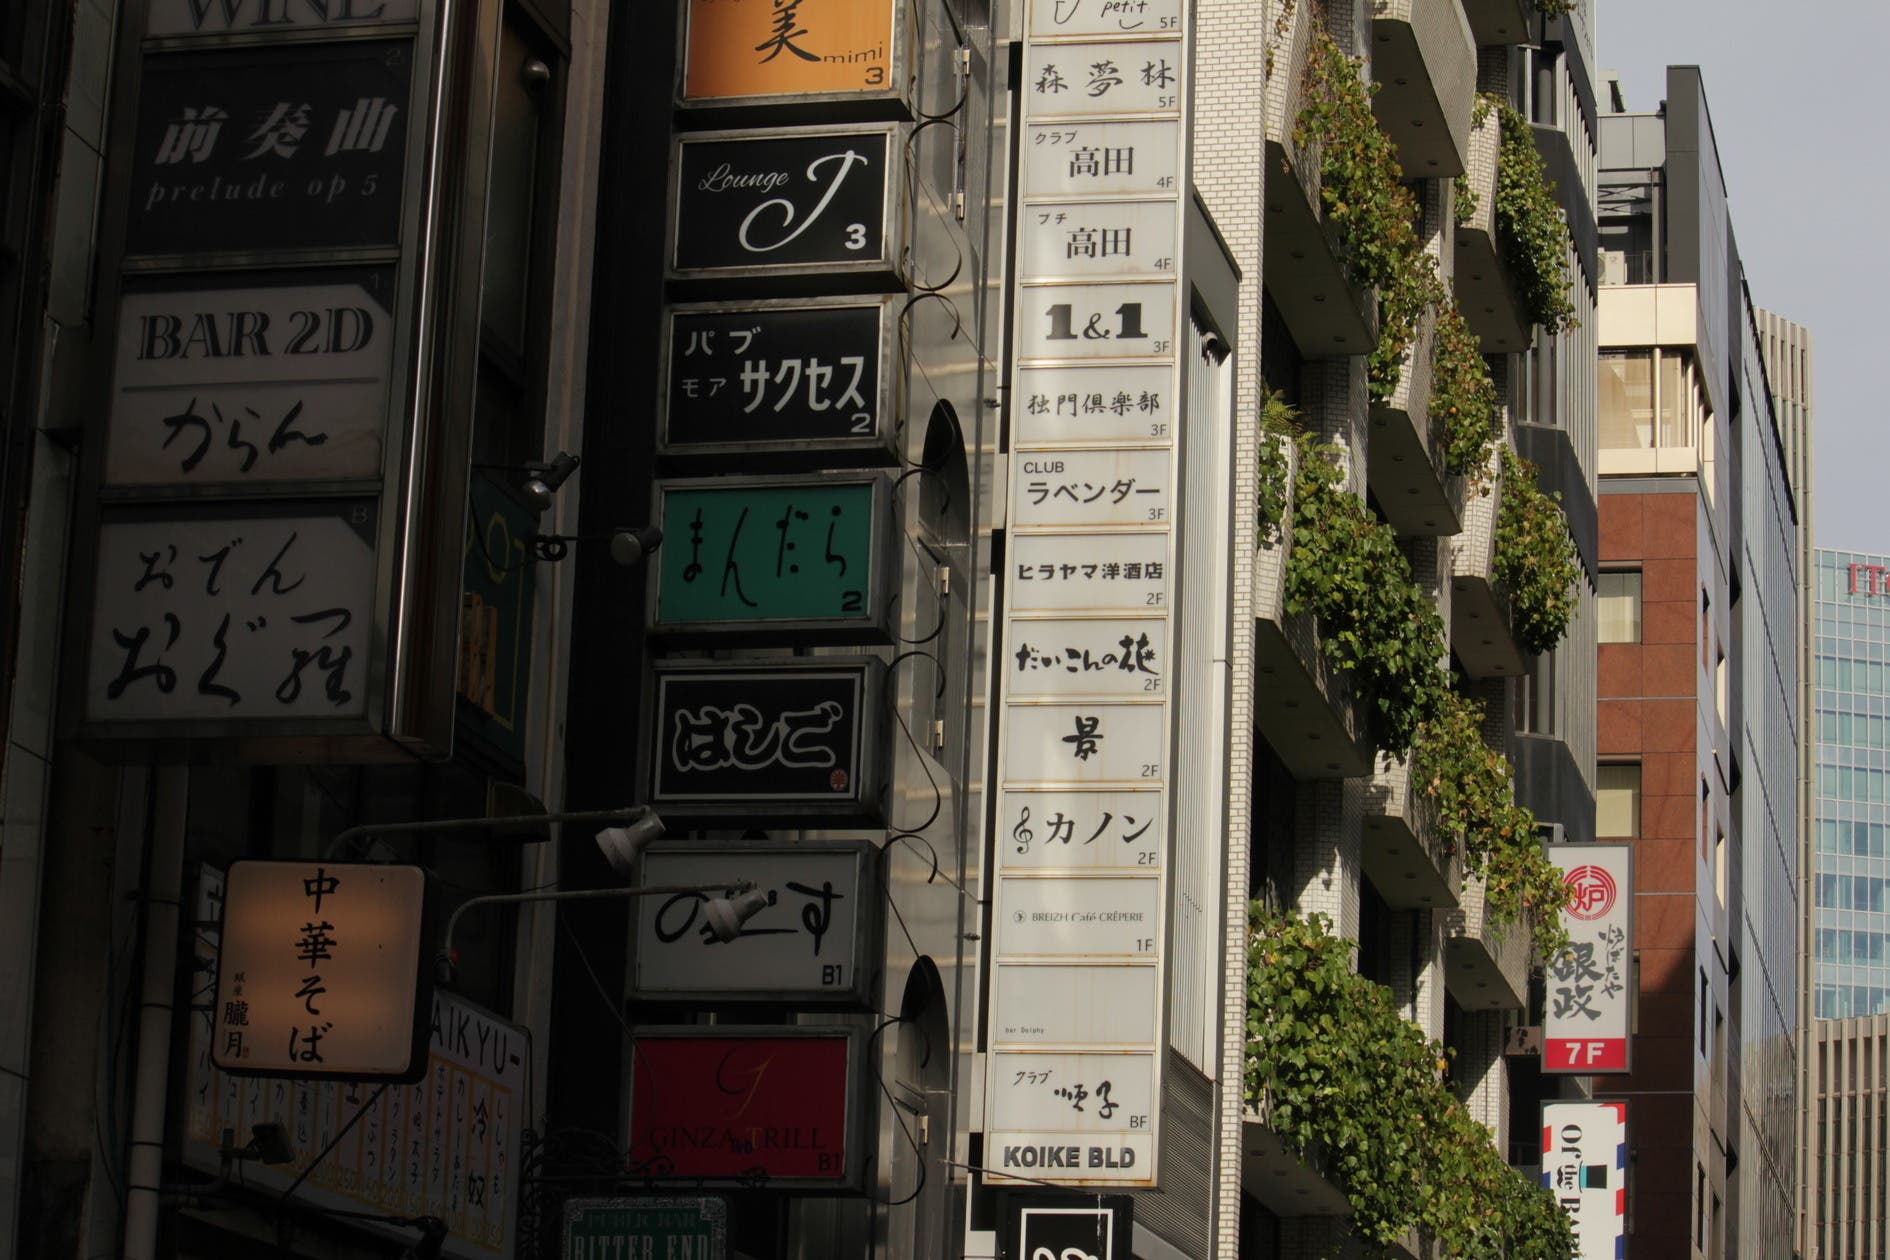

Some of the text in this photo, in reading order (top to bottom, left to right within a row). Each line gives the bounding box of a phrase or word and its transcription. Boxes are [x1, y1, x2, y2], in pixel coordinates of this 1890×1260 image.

[1160, 17, 1177, 28] 5F
[824, 41, 882, 63] mimi
[865, 67, 884, 85] 3
[1158, 97, 1176, 108] 5F
[153, 97, 399, 166] 前奏曲
[1035, 131, 1077, 144] クラブ
[1070, 147, 1134, 178] 高田
[698, 163, 790, 194] Lounge
[1156, 177, 1174, 188] 4F
[145, 173, 379, 211] prelude op 5
[845, 223, 867, 249] 3
[1067, 227, 1132, 259] 高田
[1154, 258, 1172, 269] 4F
[1046, 303, 1148, 340] 1&1
[137, 307, 373, 360] BAR 2D
[684, 325, 762, 356] パブ
[1153, 341, 1169, 353] 3F
[681, 355, 865, 414] モア サクセス
[851, 413, 871, 433] 2
[1151, 424, 1167, 436] 3F
[1024, 461, 1064, 474] CLUB
[1027, 478, 1160, 505] ラベンダー
[1148, 508, 1165, 520] 3F
[134, 532, 305, 595] おでん
[1018, 562, 1163, 580] ヒラヤマ洋酒店
[1849, 563, 1890, 595] IT
[841, 591, 862, 611] 2
[1146, 592, 1163, 605] 2F
[1015, 632, 1160, 676] だいこんの花
[1144, 679, 1161, 691] 2F
[1062, 715, 1104, 761] 景
[1141, 764, 1159, 777] 2F
[1044, 812, 1153, 845] カノン
[1138, 852, 1157, 865] 2F
[1032, 912, 1068, 922] BREIZH
[1136, 938, 1153, 952] 1F
[289, 869, 340, 1064] 中華そば
[822, 965, 842, 985] B1
[1566, 1042, 1605, 1064] 7F
[1013, 1070, 1052, 1086] クラブ
[1130, 1115, 1147, 1128] BF
[649, 1127, 735, 1150] GINZA
[1561, 1124, 1582, 1158] Of
[1003, 1146, 1136, 1169] KOIKE BLD
[1565, 1164, 1577, 1190] the
